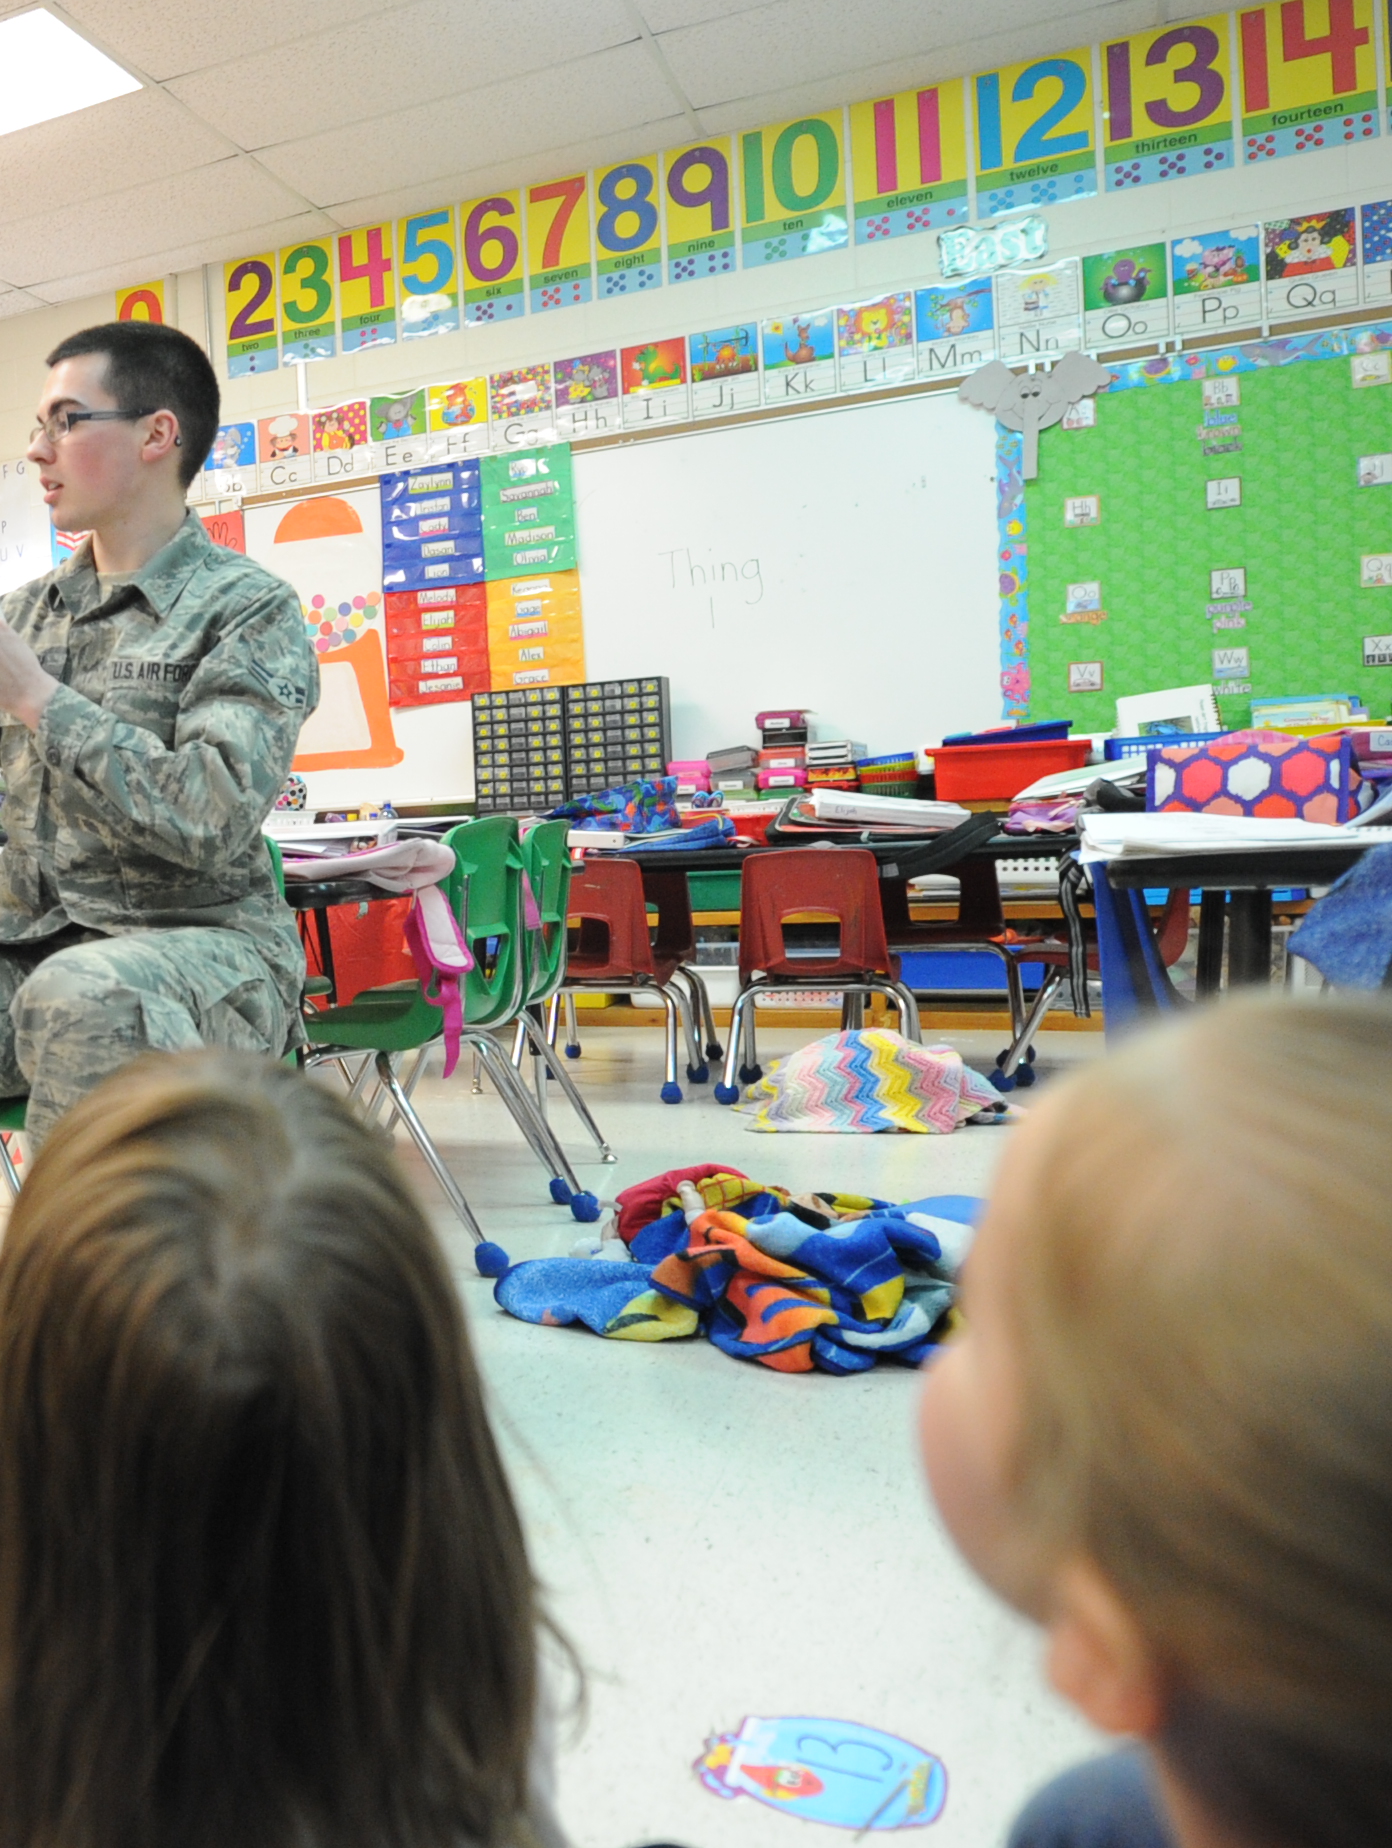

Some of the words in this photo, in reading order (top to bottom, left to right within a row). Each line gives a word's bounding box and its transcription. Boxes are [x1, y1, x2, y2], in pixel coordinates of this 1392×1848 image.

[1240, 0, 1370, 114] 14
[1106, 25, 1225, 142] 13
[976, 58, 1090, 171] 12
[1272, 101, 1344, 127] fourteen
[873, 87, 943, 195] 11
[1135, 132, 1198, 155] thirteen
[742, 118, 839, 224] 10
[1009, 161, 1059, 183] twelve
[667, 146, 729, 232] 9
[886, 189, 934, 210] eleven
[597, 163, 658, 252] 8
[529, 175, 586, 270] 7
[782, 218, 804, 232] ten
[464, 197, 519, 282] 6
[687, 237, 716, 254] nine
[401, 211, 454, 296] 5
[613, 253, 646, 270] eight
[338, 227, 392, 310] 4
[543, 268, 579, 284] seven
[282, 244, 332, 324] 3
[485, 285, 502, 298] six
[227, 260, 276, 340] 2
[1287, 283, 1336, 309] Qq
[359, 312, 382, 326] four
[1202, 297, 1240, 325] Pp
[293, 326, 321, 341] three
[1102, 312, 1147, 339] Oo
[241, 341, 259, 353] two
[1019, 329, 1059, 355] Nn
[929, 343, 983, 371] Mm
[785, 373, 816, 397] Kk
[713, 385, 735, 409] Jj
[572, 408, 608, 433] Hh
[327, 454, 355, 476] Dd
[385, 445, 414, 467] Ee
[270, 465, 298, 486] Cc
[409, 477, 452, 492] Zaylynn
[502, 486, 554, 502] Savannah
[517, 510, 536, 521] Ben
[508, 529, 554, 544] Madison
[515, 552, 547, 565] Olivia
[657, 547, 764, 605] Thing
[419, 591, 455, 604] Melody
[423, 615, 454, 629] Elijah
[510, 624, 548, 638] Abigail
[424, 639, 450, 651] Colin
[520, 648, 542, 660] Alex
[112, 662, 134, 679] U.S.
[137, 662, 160, 681] AIR
[423, 660, 456, 672] Ethan
[514, 673, 548, 685] Grace
